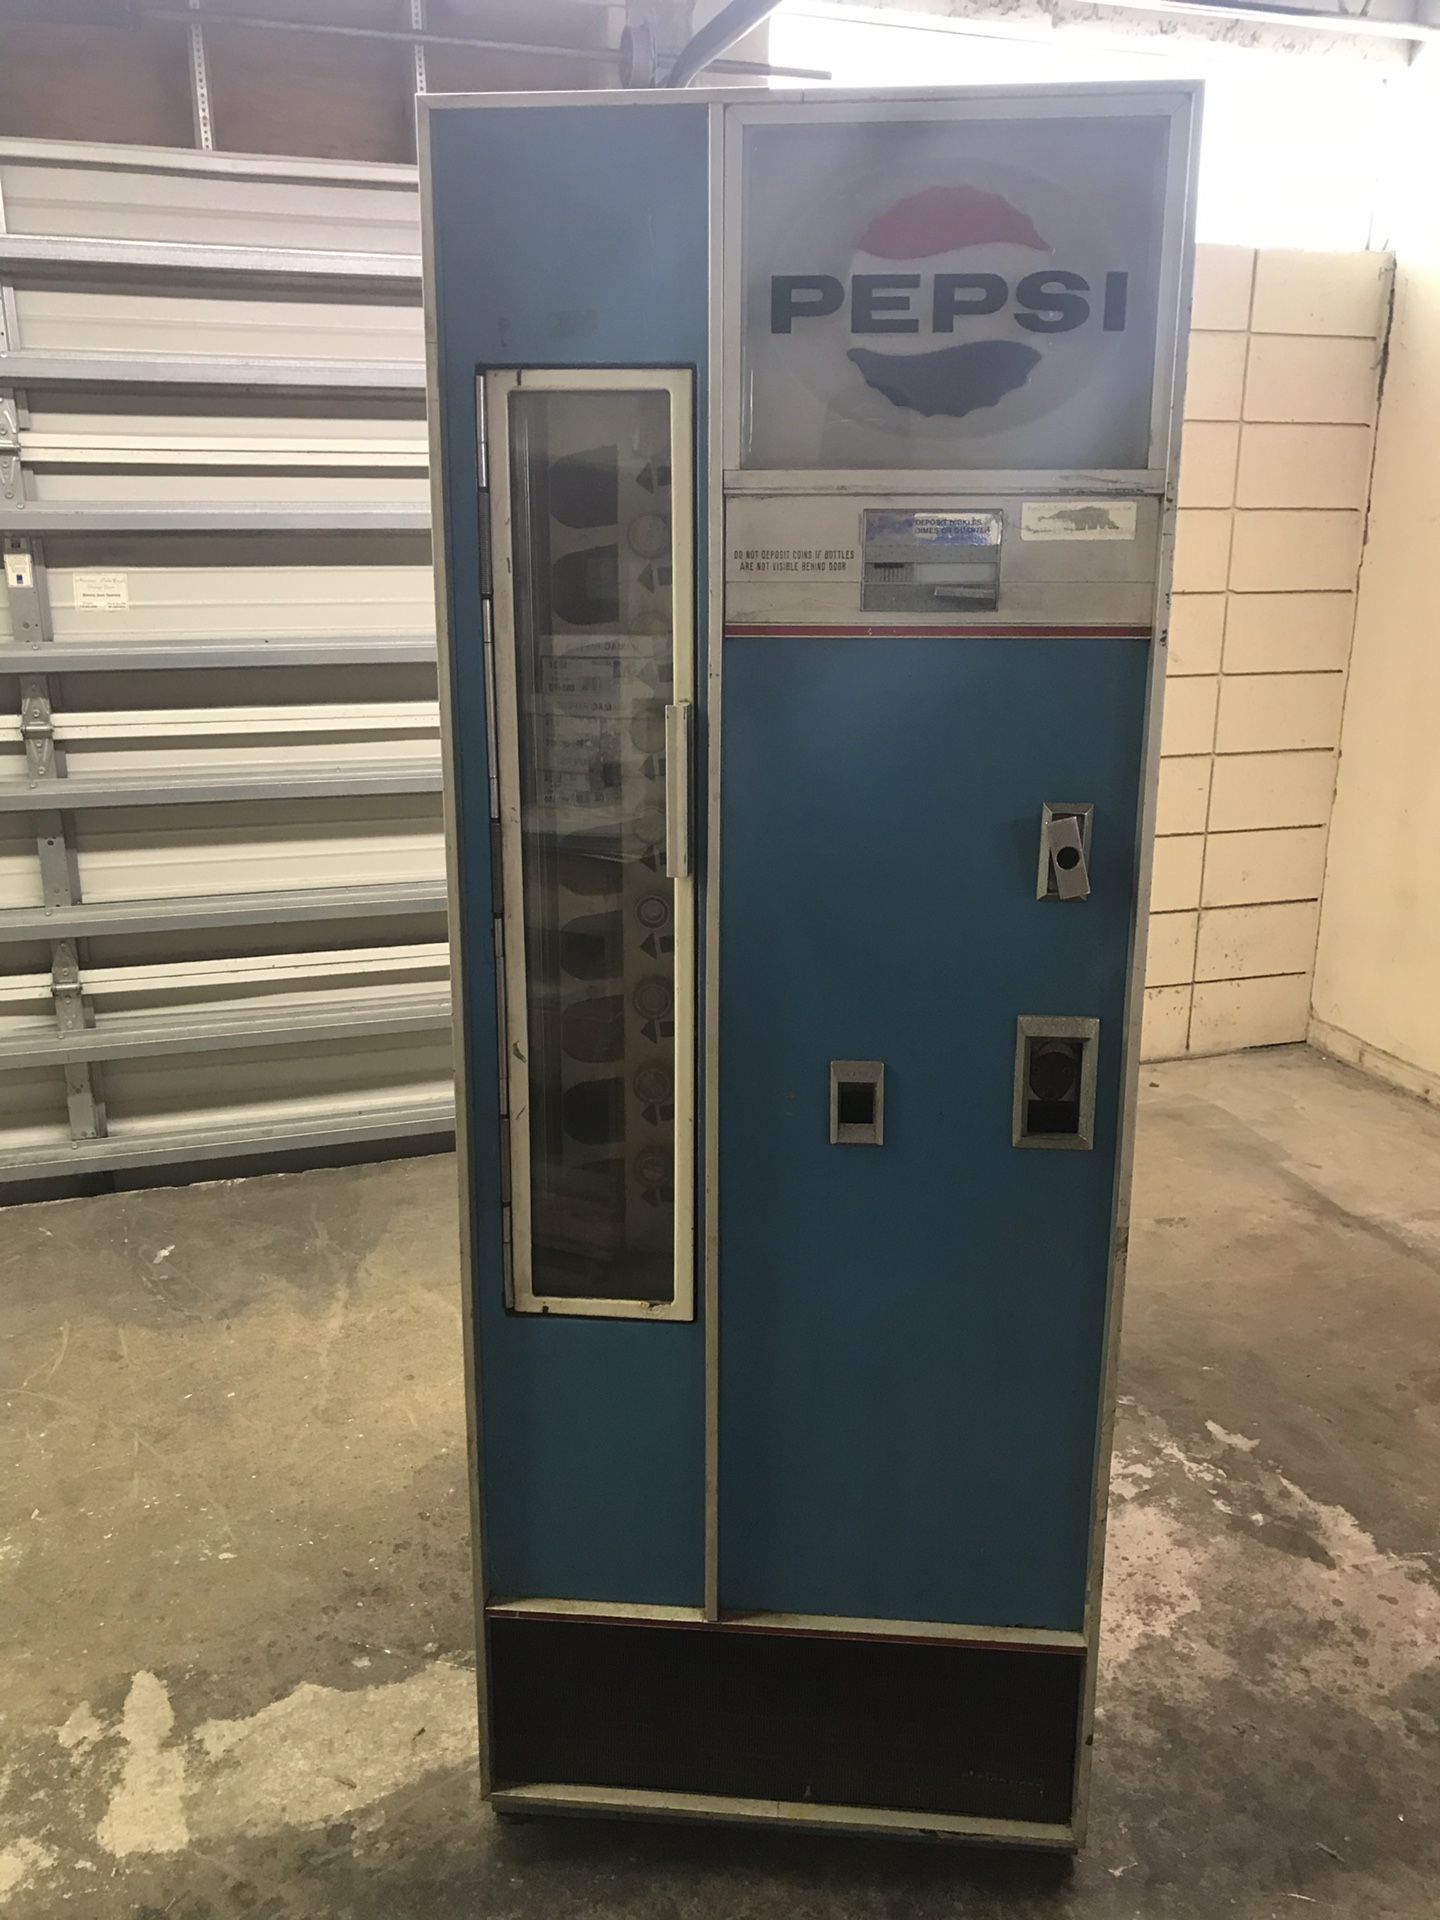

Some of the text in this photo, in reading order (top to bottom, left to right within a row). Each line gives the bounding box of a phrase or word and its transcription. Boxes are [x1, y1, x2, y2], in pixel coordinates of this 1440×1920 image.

[770, 270, 1130, 334] PEPSI
[733, 550, 855, 560] DO NOT DEPOSIT COINS IF BOTTLES
[739, 561, 847, 571] ARE NOT VISIBLE BEHIND DOOR
